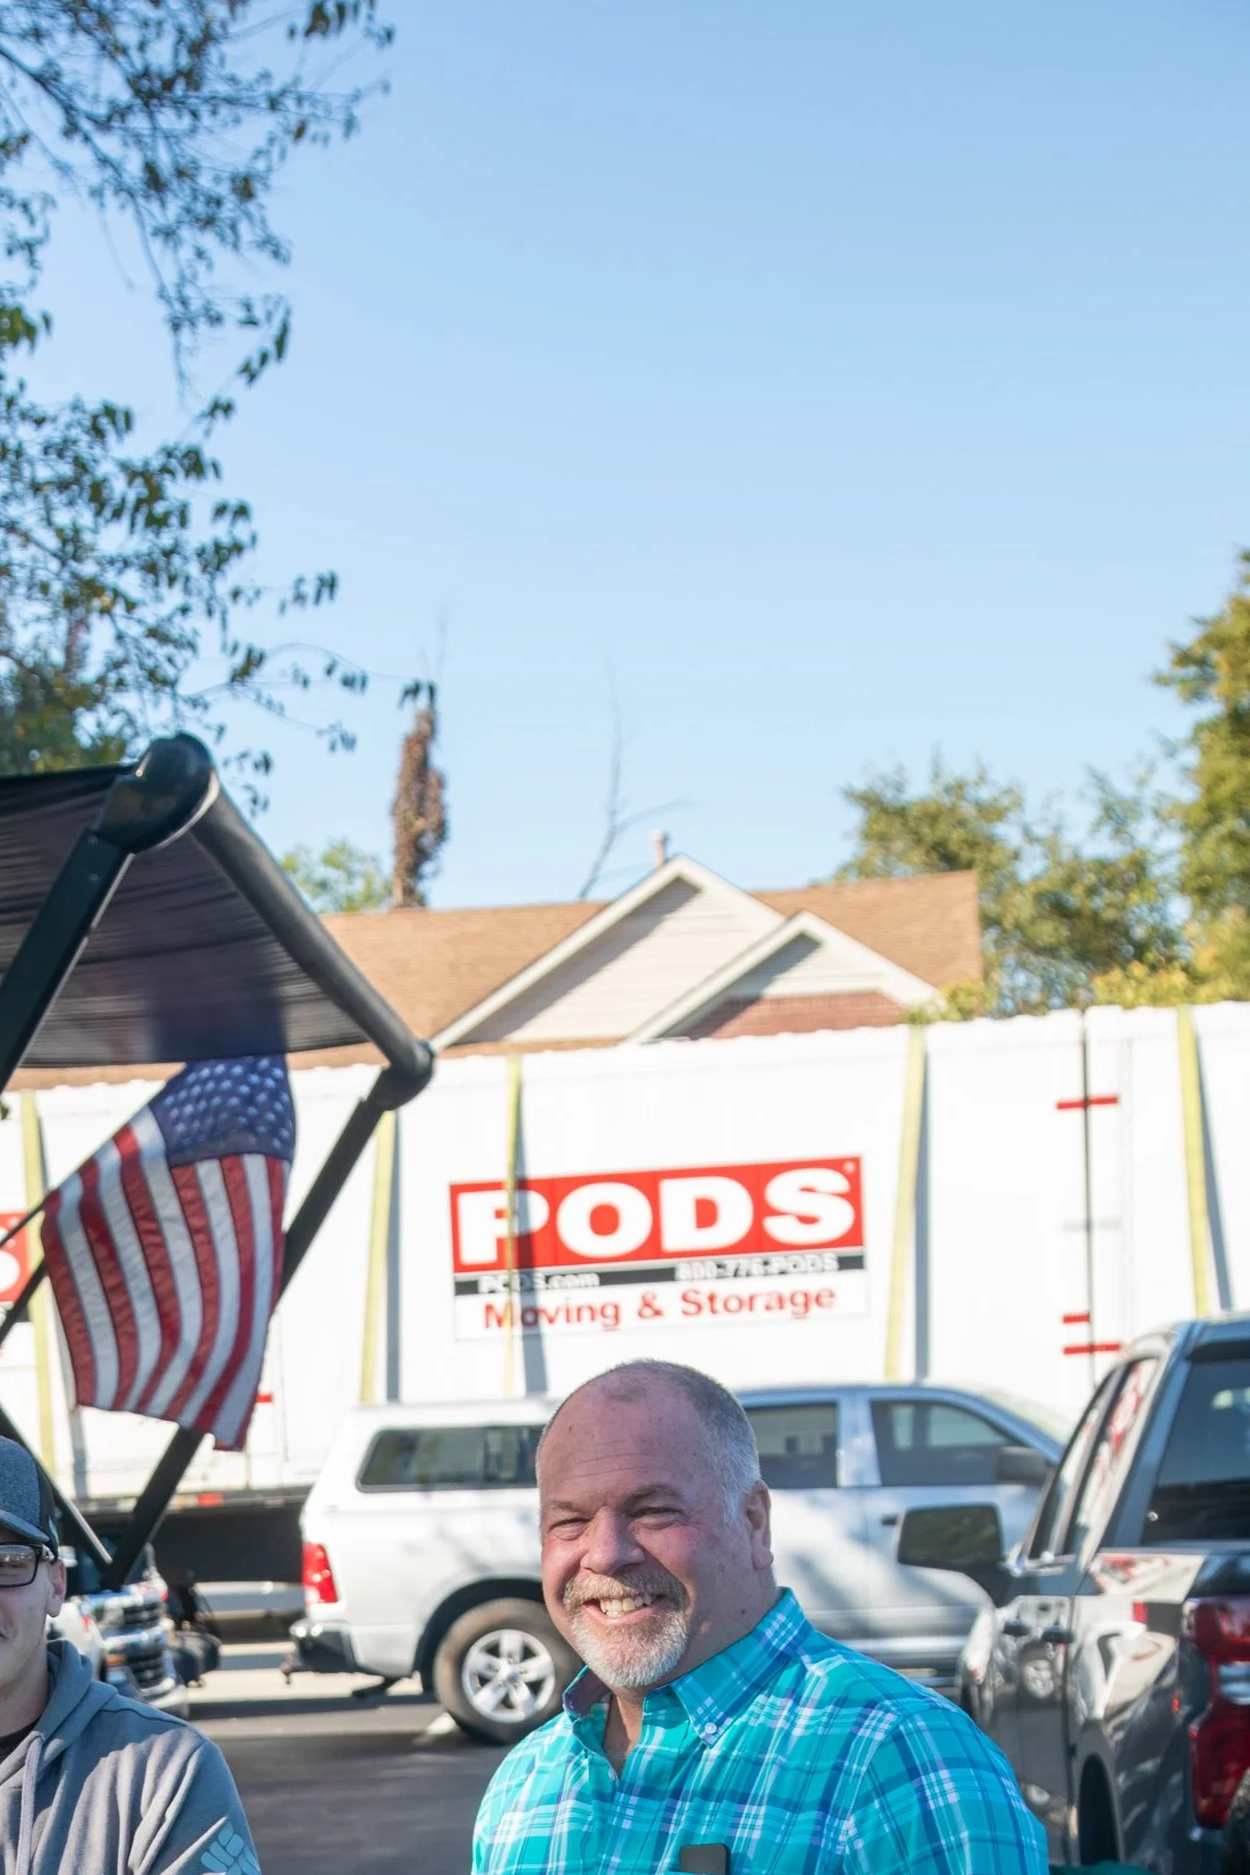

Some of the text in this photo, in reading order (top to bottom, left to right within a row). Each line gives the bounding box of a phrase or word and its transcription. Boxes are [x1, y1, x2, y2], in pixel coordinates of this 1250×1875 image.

[457, 1168, 855, 1265] PODS
[485, 1288, 835, 1331] Moving & Storage
